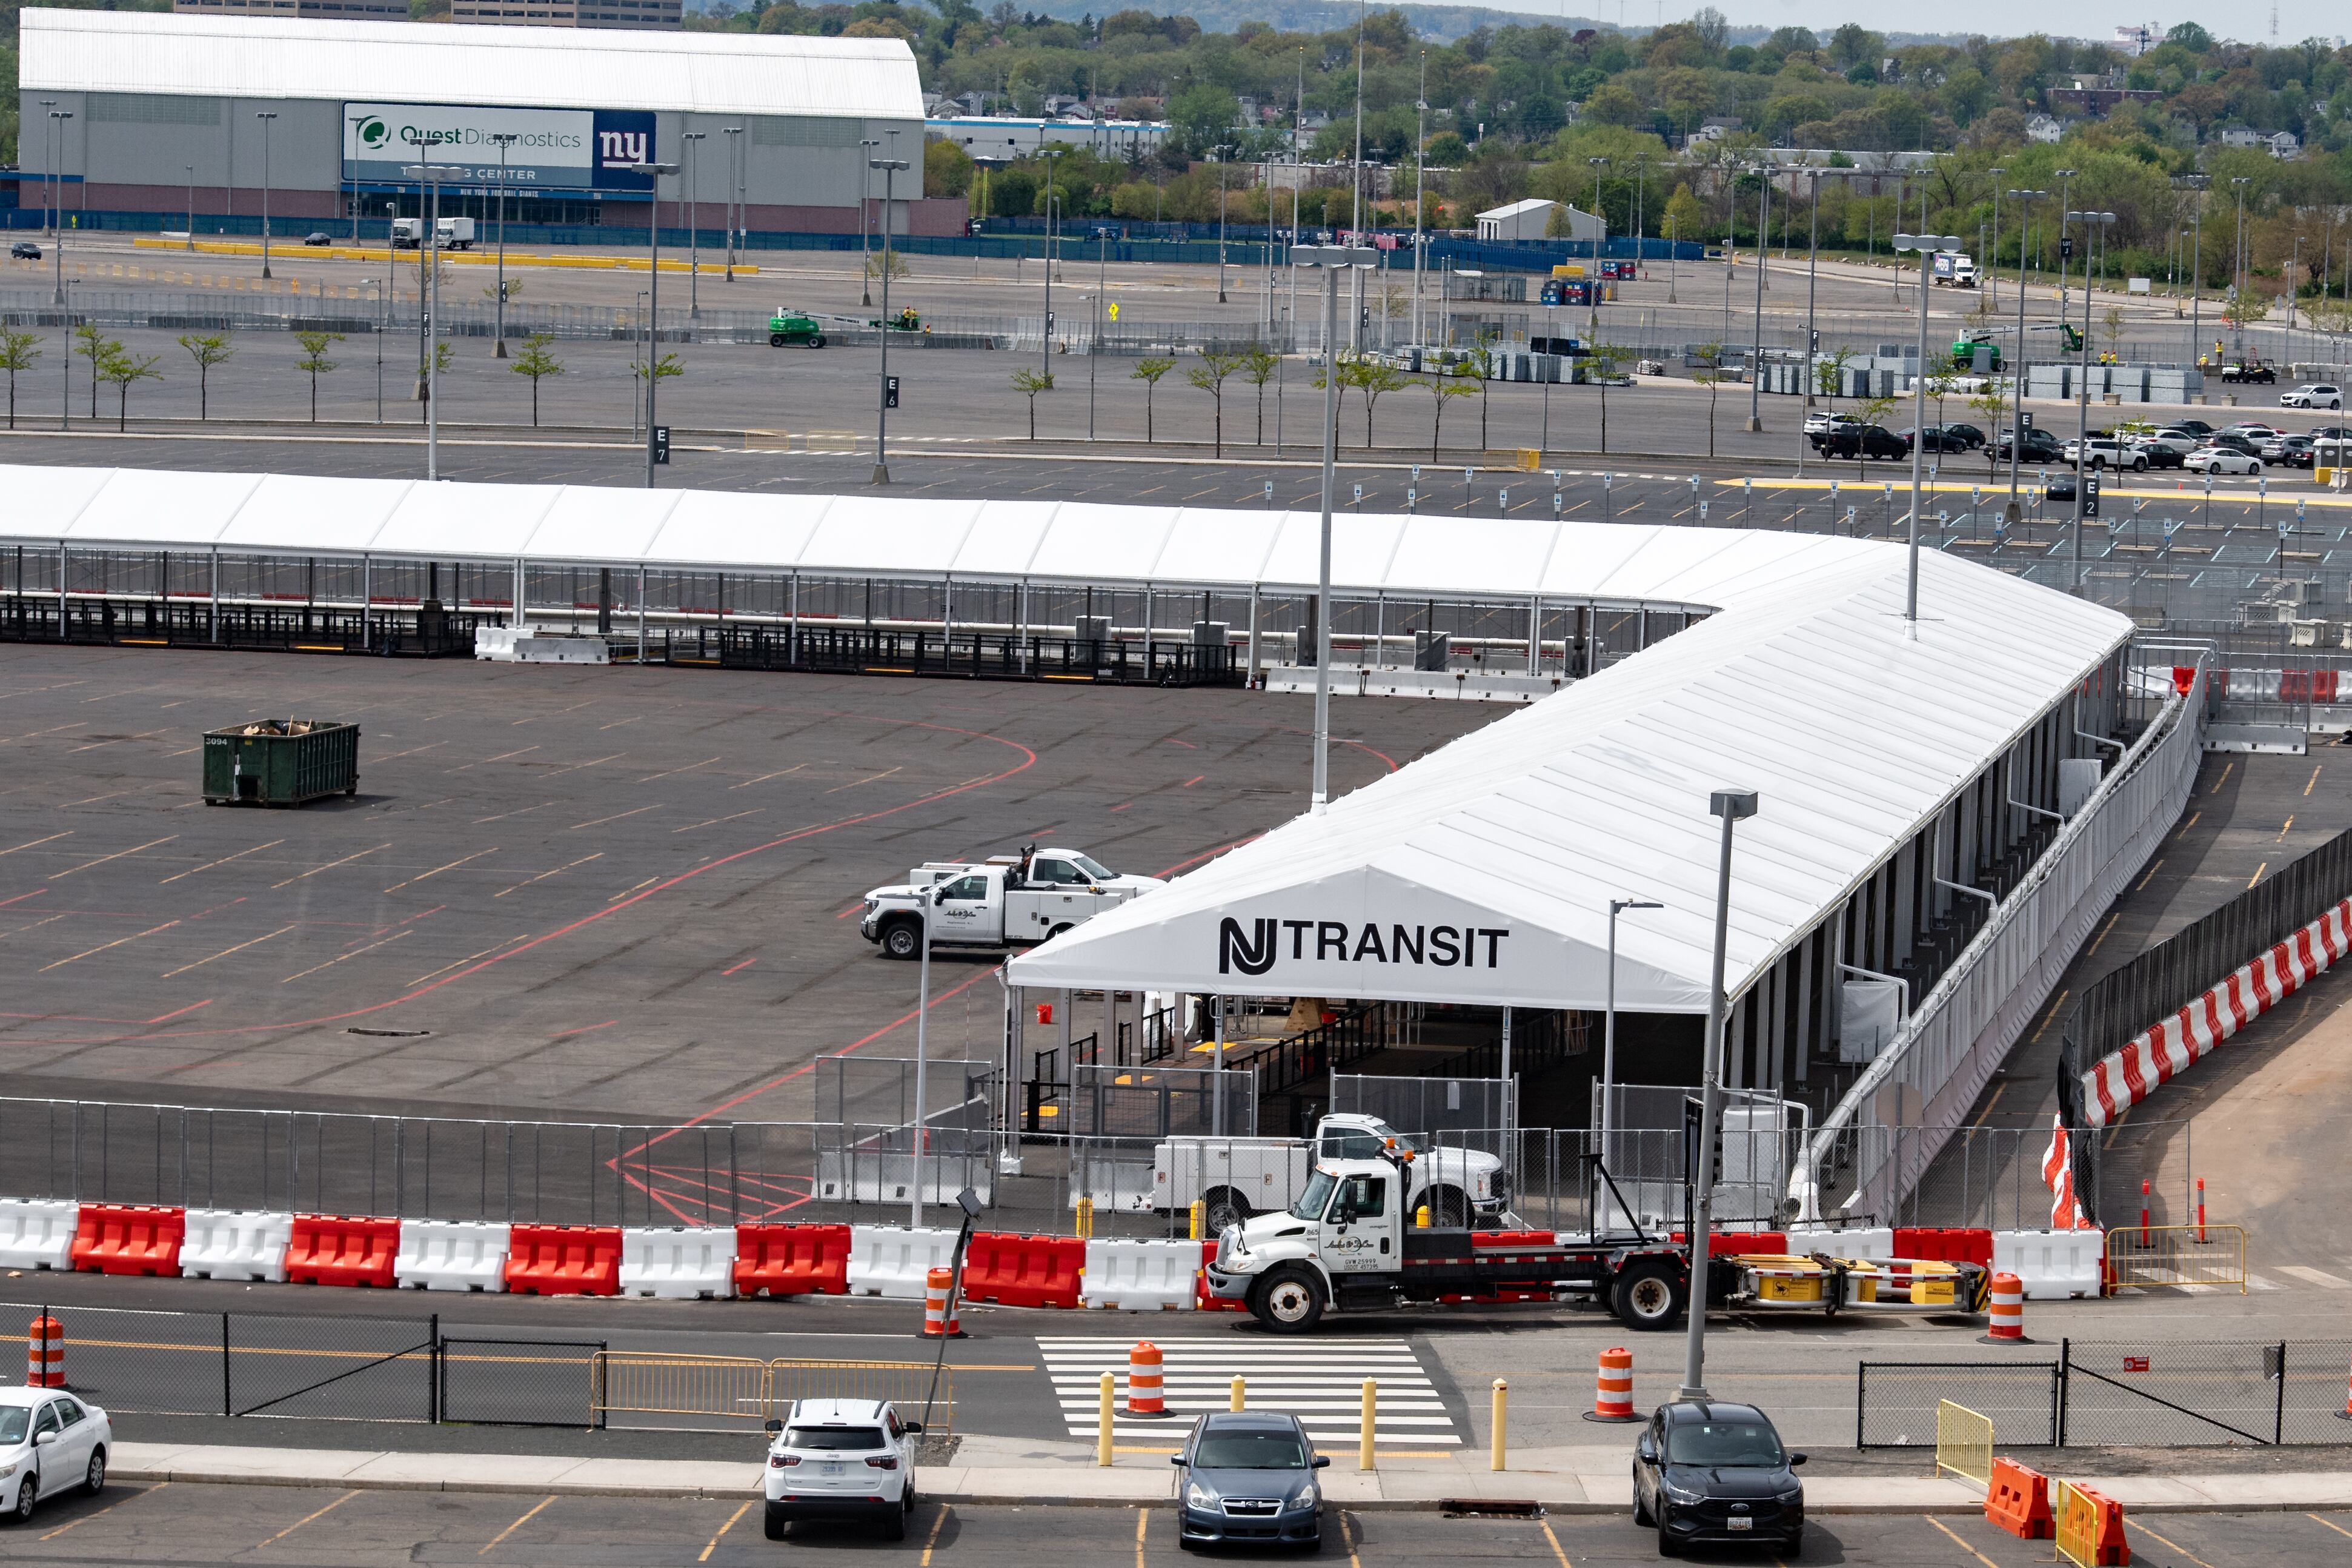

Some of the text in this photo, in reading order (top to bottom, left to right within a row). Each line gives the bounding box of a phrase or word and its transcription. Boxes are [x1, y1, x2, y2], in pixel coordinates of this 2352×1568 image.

[400, 125, 580, 148] Quest Diagnostics
[477, 168, 536, 180] CENTER
[424, 314, 428, 322] F
[424, 327, 428, 336] 5
[889, 379, 896, 390] E
[889, 396, 895, 406] 6
[2022, 415, 2030, 425] E
[657, 430, 666, 442] E
[2024, 431, 2027, 442] 1
[658, 450, 665, 461] 7
[2087, 482, 2096, 494] E
[2087, 502, 2095, 514] 2
[1218, 917, 1509, 975] NJ TRANSIT
